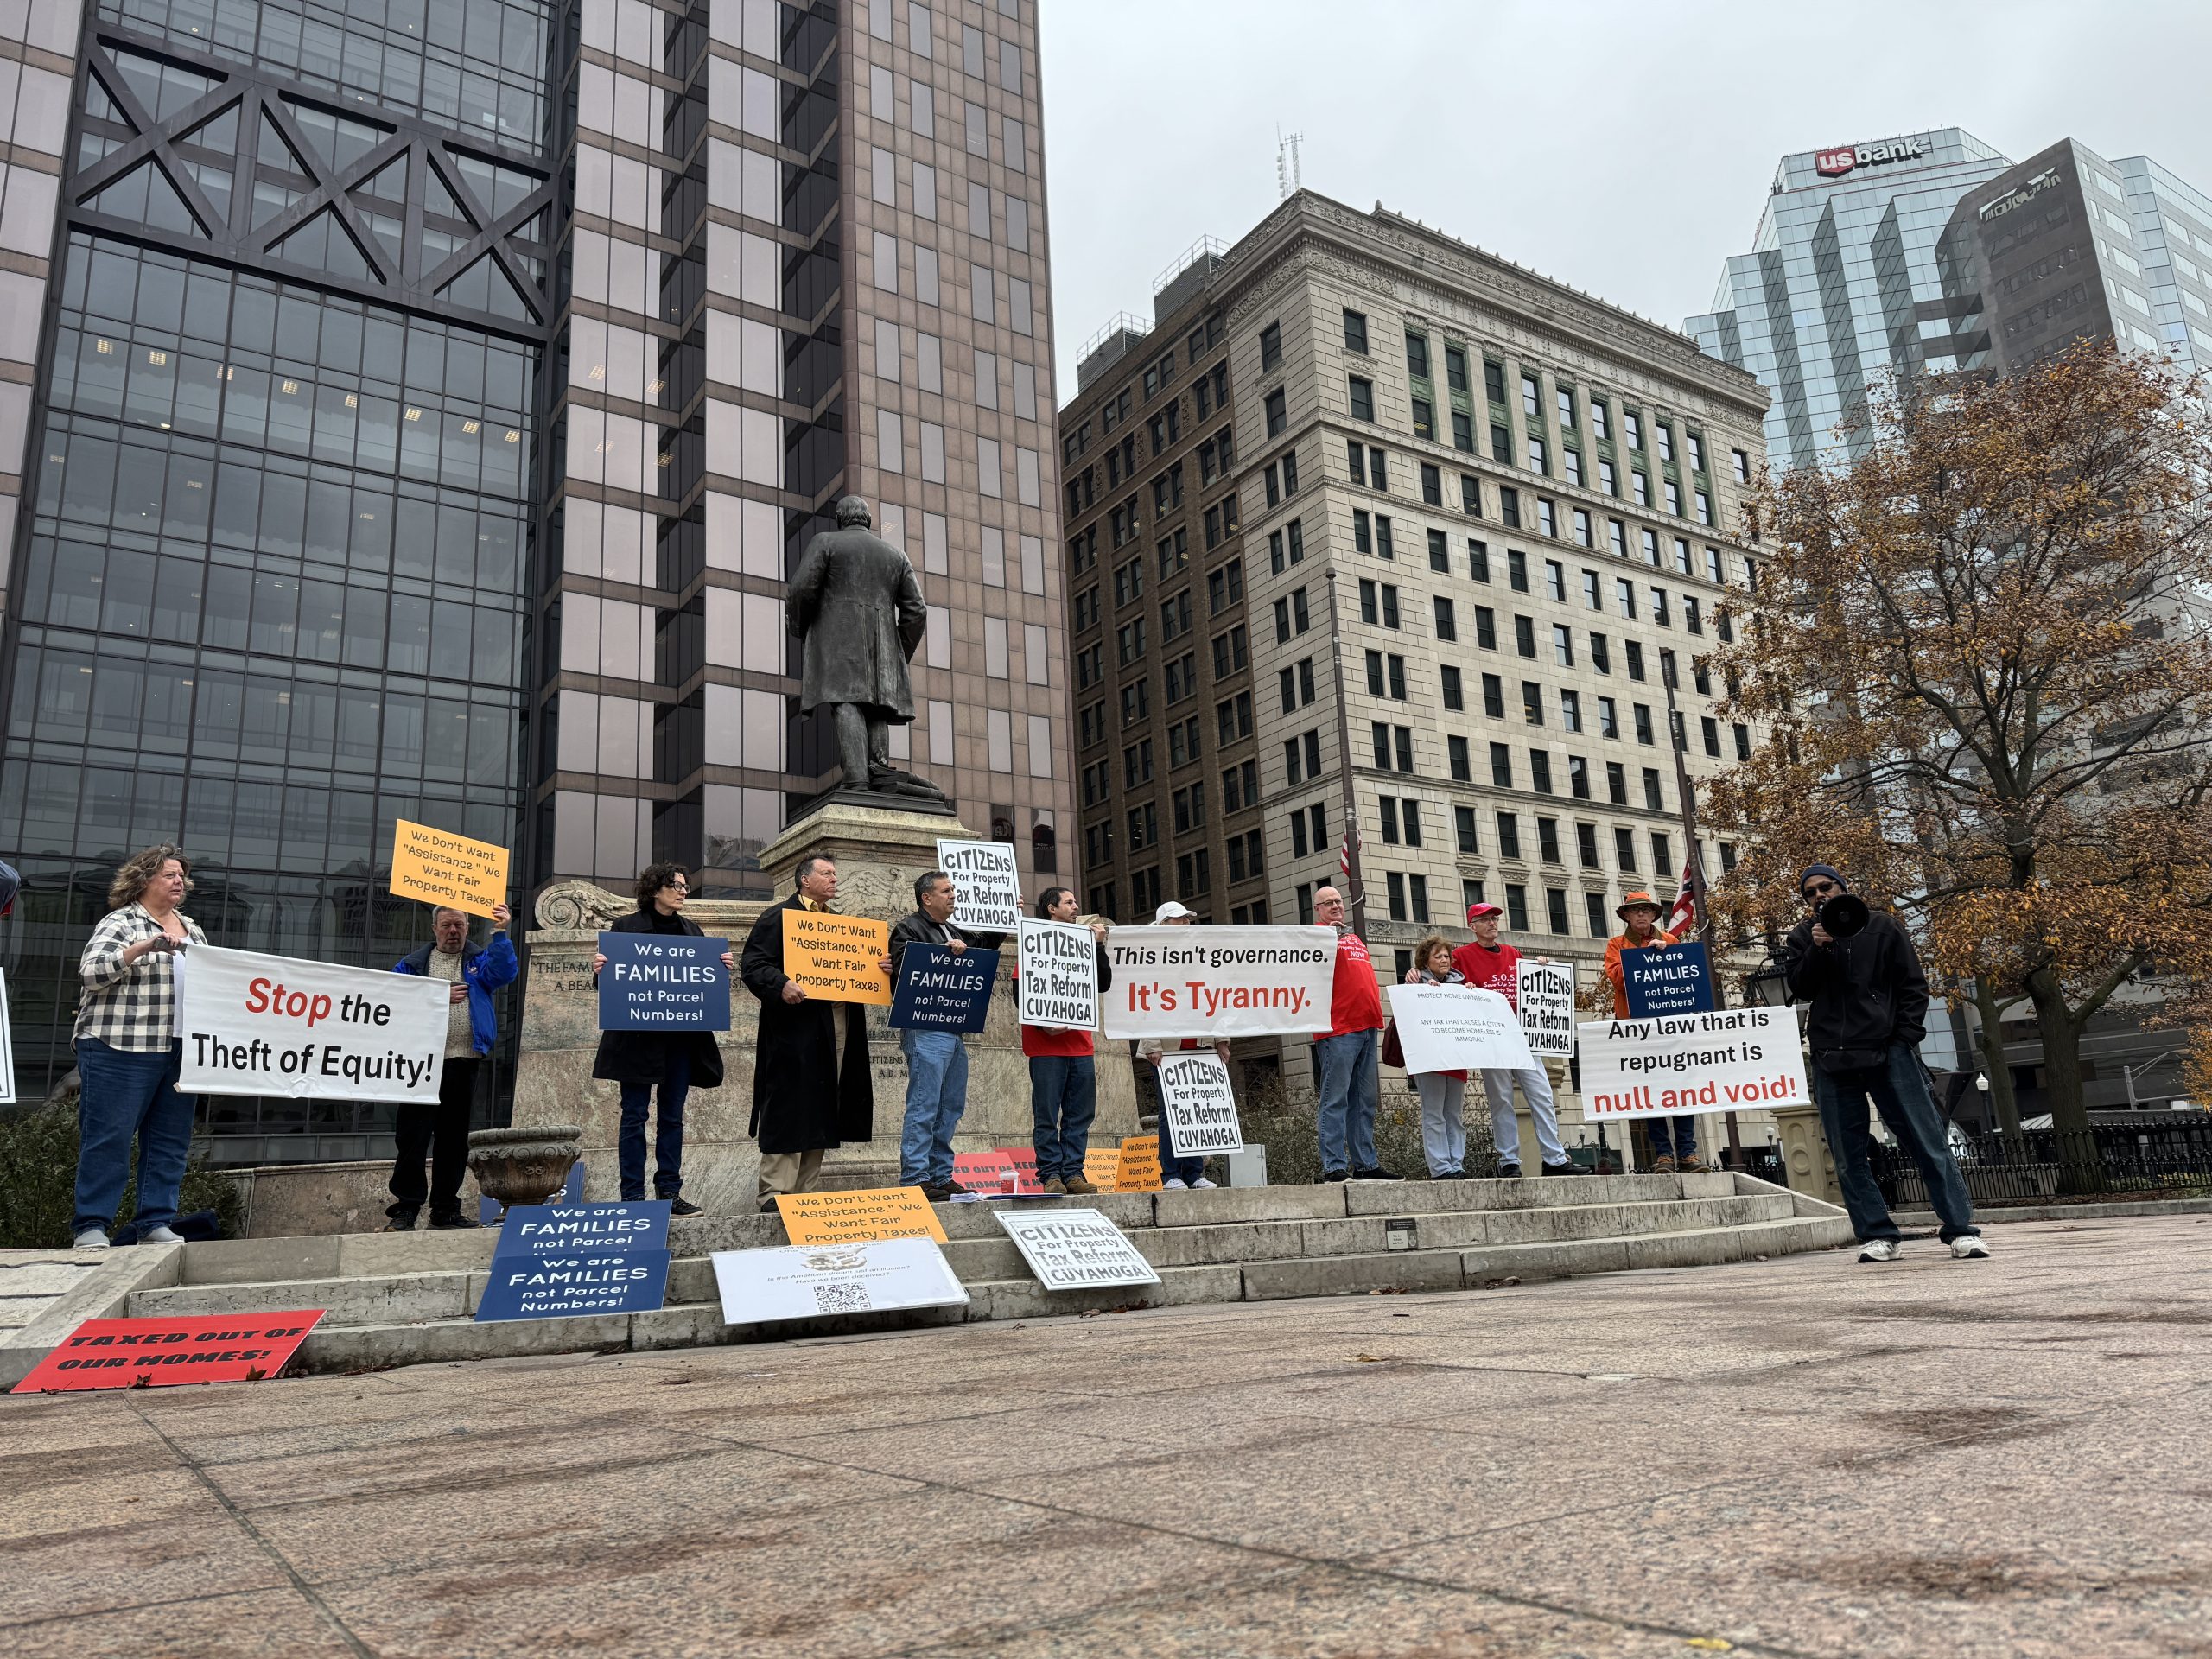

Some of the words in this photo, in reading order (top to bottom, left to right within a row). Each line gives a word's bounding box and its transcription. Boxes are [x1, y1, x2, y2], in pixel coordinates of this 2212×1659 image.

[411, 830, 429, 842] We
[433, 836, 463, 852] Don't
[467, 845, 496, 861] Want
[404, 844, 480, 871] "Assistance."
[484, 866, 499, 878] We
[944, 849, 1011, 872] CITIZENS
[423, 865, 454, 881] Want
[458, 874, 480, 887] Fair
[952, 872, 969, 881] For
[973, 873, 1009, 887] Property
[403, 876, 456, 899] Property
[461, 890, 495, 907] Taxes!
[953, 884, 970, 903] ax
[973, 886, 1014, 906] Reform
[954, 907, 1016, 925] CUYAHOGA
[798, 920, 814, 931] We
[817, 922, 846, 935] Don't
[849, 925, 876, 938] Want
[634, 943, 662, 956] We
[669, 948, 695, 957] are
[791, 937, 864, 954] "Assistance."
[868, 945, 882, 957] We
[1025, 931, 1091, 959] CITIZENS
[812, 957, 842, 970] Want
[845, 960, 865, 971] Fair
[931, 953, 950, 965] We
[954, 957, 974, 967] are
[1113, 947, 1156, 964] This
[1162, 946, 1206, 964] isn't
[1211, 948, 1328, 968] governance.
[1643, 953, 1662, 963] We
[615, 964, 715, 982] FAMILIES
[1031, 957, 1048, 968] For
[1052, 958, 1090, 976] Property
[1634, 965, 1700, 983] FAMILIES
[796, 974, 846, 991] Property
[849, 979, 881, 992] Taxes!
[910, 971, 983, 990] FAMILIES
[1026, 971, 1046, 995] Tax
[1051, 974, 1091, 999] Reform
[1522, 969, 1570, 995] CITIZENS
[628, 990, 652, 1001] not
[658, 990, 703, 1002] Parcel
[1129, 982, 1177, 1011] It's
[1185, 982, 1310, 1017] Tyranny.
[1645, 988, 1661, 997] not
[1664, 984, 1694, 995] Parcel
[245, 978, 331, 1027] Stop
[341, 994, 391, 1026] the
[915, 995, 933, 1005] not
[937, 996, 970, 1007] Parcel
[1027, 998, 1091, 1021] CUYAHOGA
[1527, 995, 1539, 1005] For
[1541, 995, 1568, 1010] Property
[1648, 997, 1695, 1010] Numbers!
[630, 1008, 702, 1020] Numbers!
[912, 1010, 966, 1023] Numbers!
[1522, 1008, 1537, 1028] Tax
[1541, 1009, 1569, 1031] Reform
[1609, 1021, 1650, 1040] Any
[1656, 1018, 1695, 1034] law
[1701, 1012, 1745, 1032] that
[1751, 1010, 1769, 1027] is
[192, 1033, 271, 1071] Theft
[280, 1044, 315, 1073] of
[321, 1046, 433, 1088] Equity!
[1620, 1046, 1736, 1073] repugnant
[1742, 1042, 1762, 1061] is
[1165, 1059, 1224, 1085] CITIZENS
[1173, 1089, 1189, 1099] For
[1192, 1087, 1224, 1101] Property
[1594, 1085, 1654, 1113] null
[1662, 1081, 1717, 1108] and
[1724, 1075, 1796, 1103] void!
[1172, 1104, 1193, 1126] Tax
[1193, 1102, 1232, 1124] Reform
[1179, 1128, 1236, 1147] CUYAHOGA
[964, 1180, 1001, 1189] HOME
[1120, 1180, 1141, 1189] Property
[824, 1195, 866, 1205] Don't
[868, 1192, 910, 1201] Want
[552, 1209, 586, 1217] We
[791, 1204, 894, 1218] "Assistance."
[520, 1219, 651, 1235] FAMILIES
[824, 1219, 867, 1228] Want
[1020, 1223, 1116, 1241] CITIZENS
[533, 1239, 565, 1249] not
[572, 1236, 632, 1247] Parcel
[804, 1230, 878, 1243] Property
[881, 1226, 931, 1236] Taxes!
[1065, 1238, 1118, 1248] Property
[543, 1259, 579, 1268] We
[1036, 1252, 1068, 1267] Tax
[1071, 1248, 1136, 1266] Reform
[509, 1268, 648, 1287] FAMILIES
[1051, 1265, 1147, 1282] CUYAHOGA
[522, 1289, 556, 1299] not
[563, 1285, 628, 1296] Parcel
[520, 1298, 623, 1312] Numbers!
[70, 1332, 189, 1346] TAXED
[194, 1330, 260, 1342] OUT
[264, 1328, 306, 1338] OF
[57, 1357, 129, 1370] OUR
[133, 1350, 273, 1366] HOMES!
